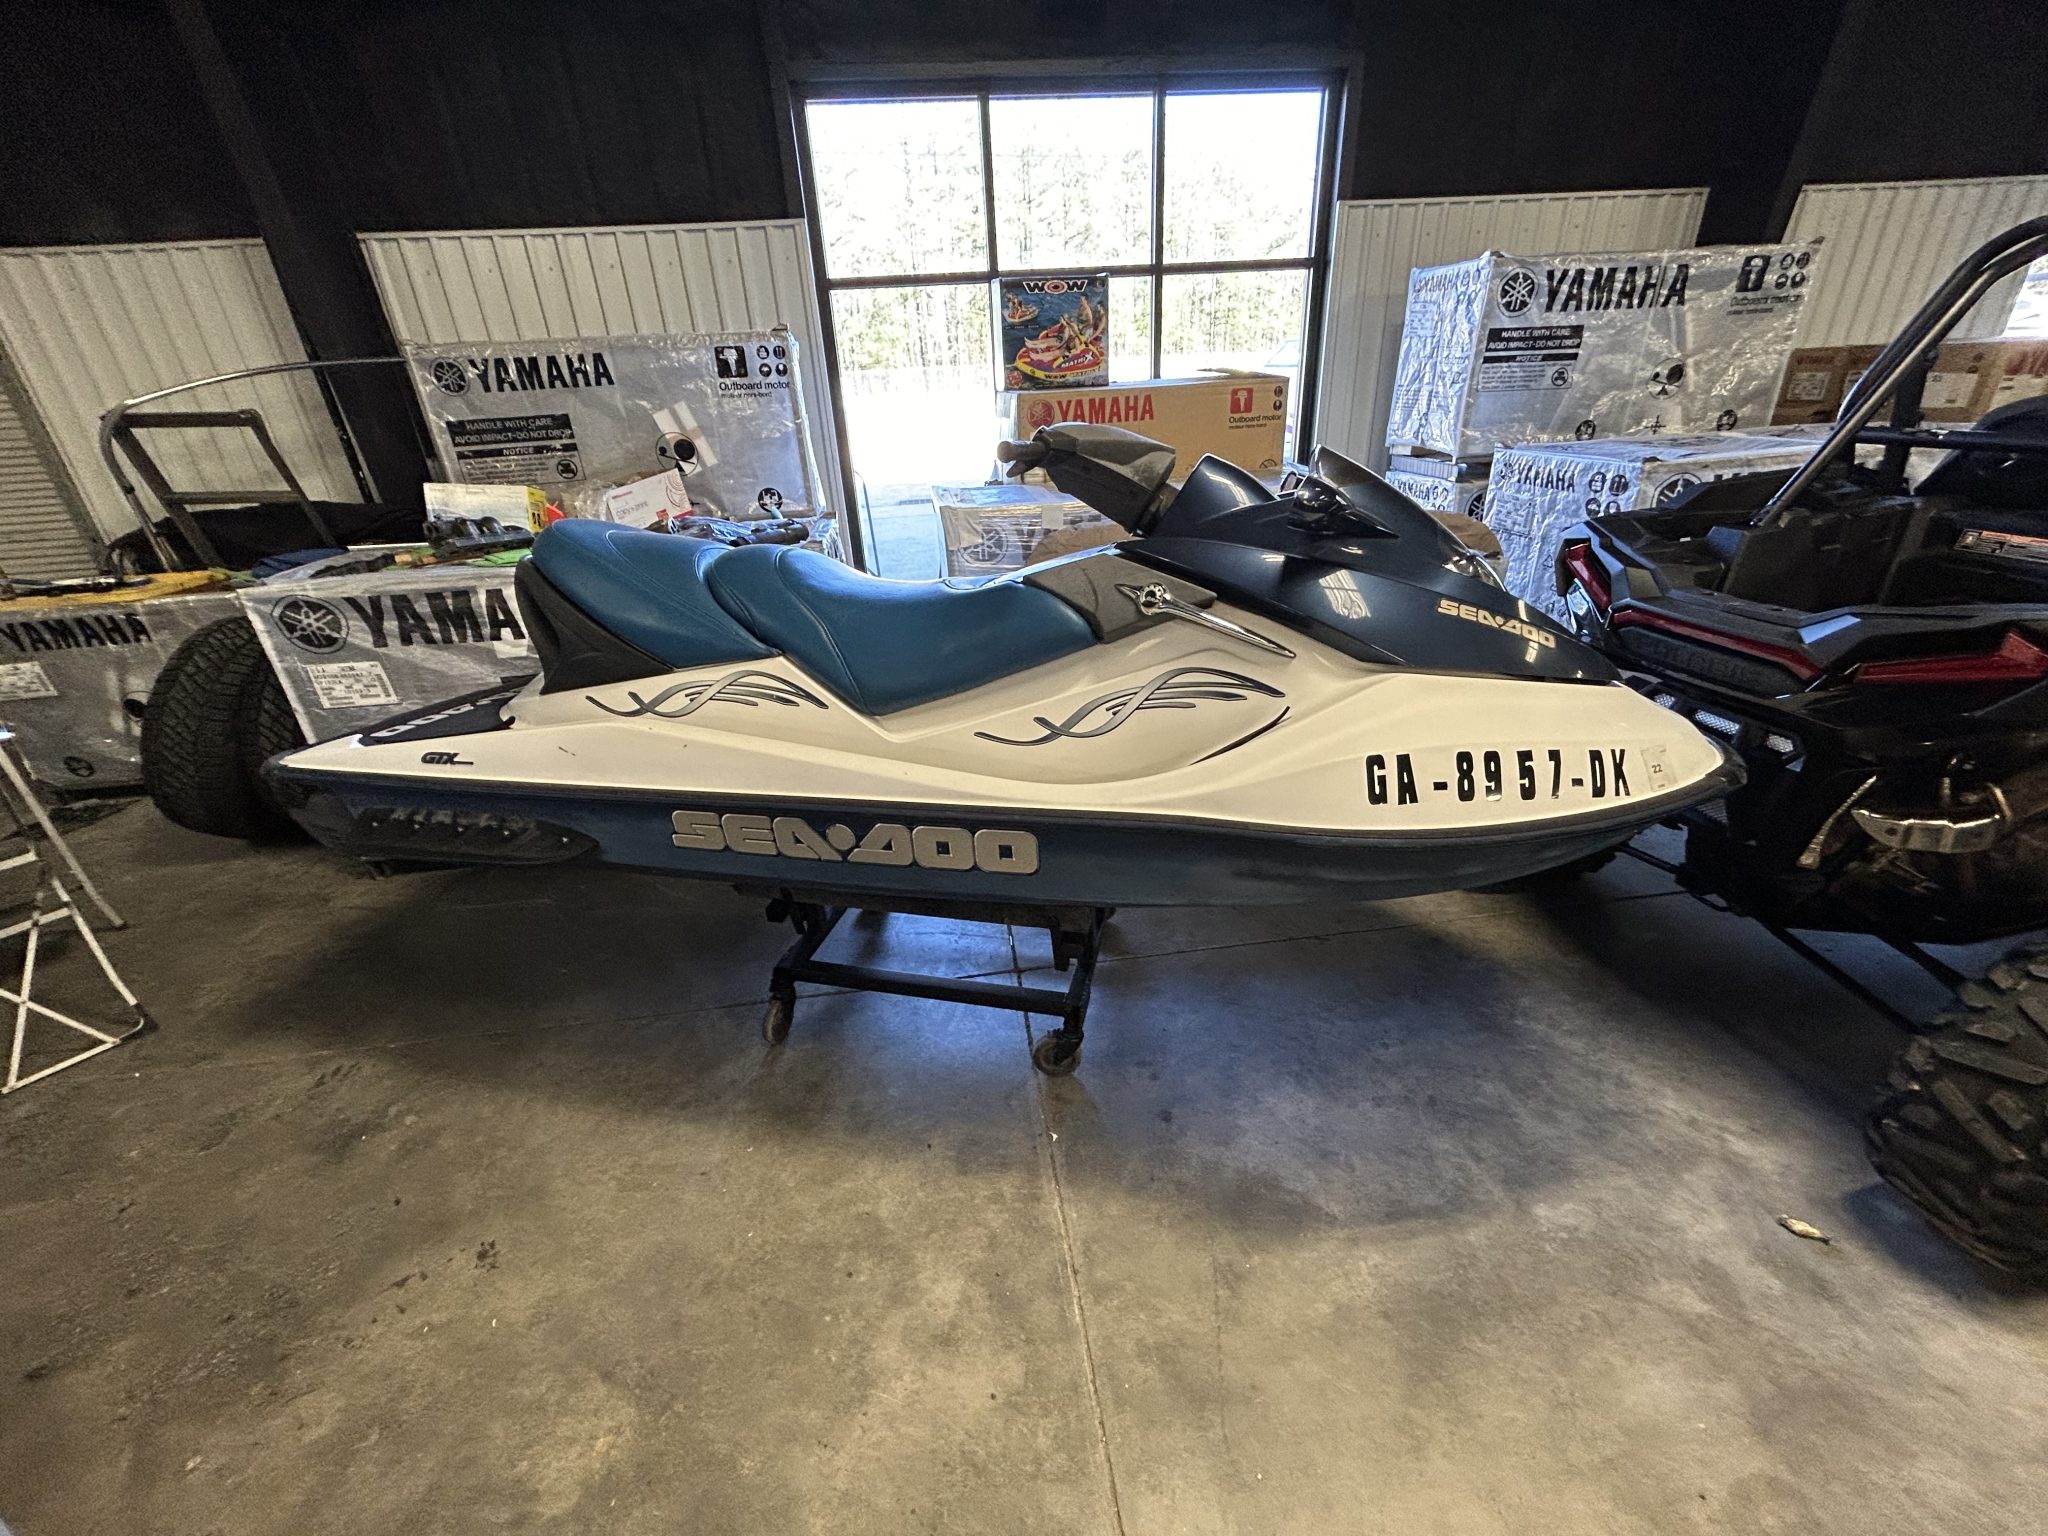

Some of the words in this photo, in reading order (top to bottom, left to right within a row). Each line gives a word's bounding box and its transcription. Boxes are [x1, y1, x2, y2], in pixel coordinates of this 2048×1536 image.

[1023, 280, 1088, 294] WOW
[1544, 264, 1689, 312] YAMAHA
[1501, 329, 1531, 338] HANDLE
[1531, 328, 1550, 337] WITH
[1551, 328, 1571, 336] CARE
[1487, 341, 1507, 350] AVOID
[1546, 339, 1561, 347] NOT
[1561, 338, 1581, 347] DROP
[1061, 352, 1094, 368] MATRIX
[1515, 354, 1544, 362] NOTICE
[468, 352, 615, 393] YAMAHA
[719, 381, 763, 391] Outboard
[764, 381, 790, 390] motor
[1056, 394, 1154, 424] YAMAHA
[465, 420, 503, 431] HANDLE
[504, 418, 529, 429] WITH
[528, 417, 554, 428] CARE
[1228, 414, 1261, 424] Outboard
[454, 434, 481, 444] AVOID
[530, 429, 548, 438] NOT
[548, 428, 572, 438] DROP
[502, 446, 535, 456] NOTICE
[1517, 463, 1575, 493] YAMAHA
[341, 588, 527, 648] YAMA
[0, 613, 152, 651] YAMAHA
[420, 751, 475, 765] GTX
[1651, 763, 1663, 774] 22
